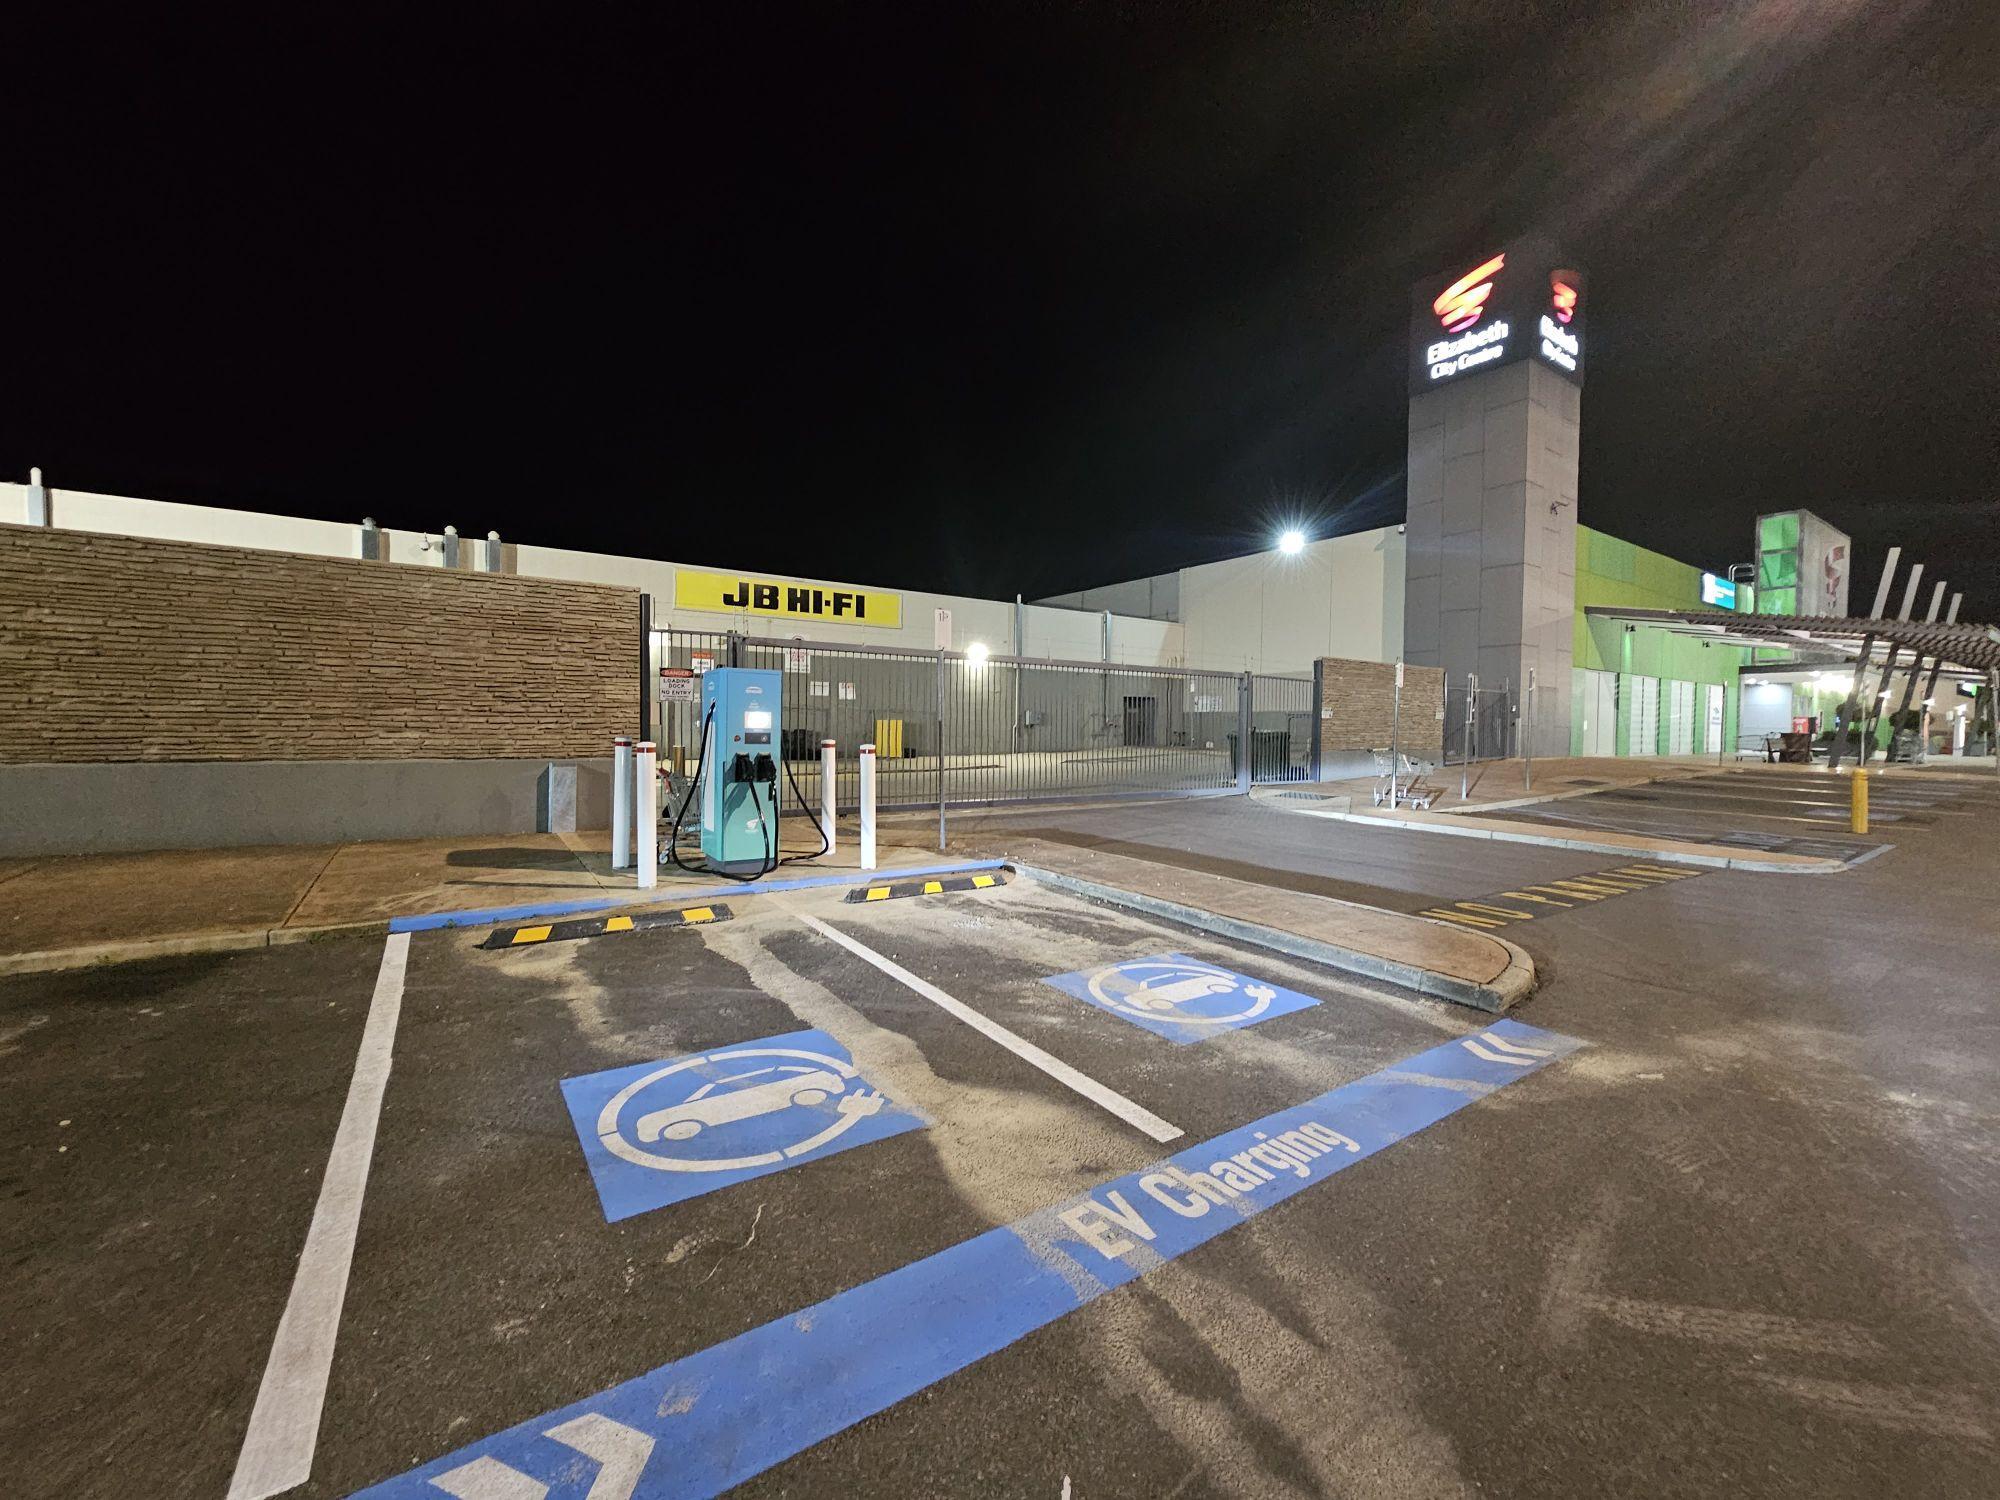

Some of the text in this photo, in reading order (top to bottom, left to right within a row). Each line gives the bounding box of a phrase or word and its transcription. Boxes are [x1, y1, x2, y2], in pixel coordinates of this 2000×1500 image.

[722, 581, 865, 618] JB HI-FI
[1419, 902, 1534, 928] NO
[1057, 1121, 1361, 1259] EV Charging
